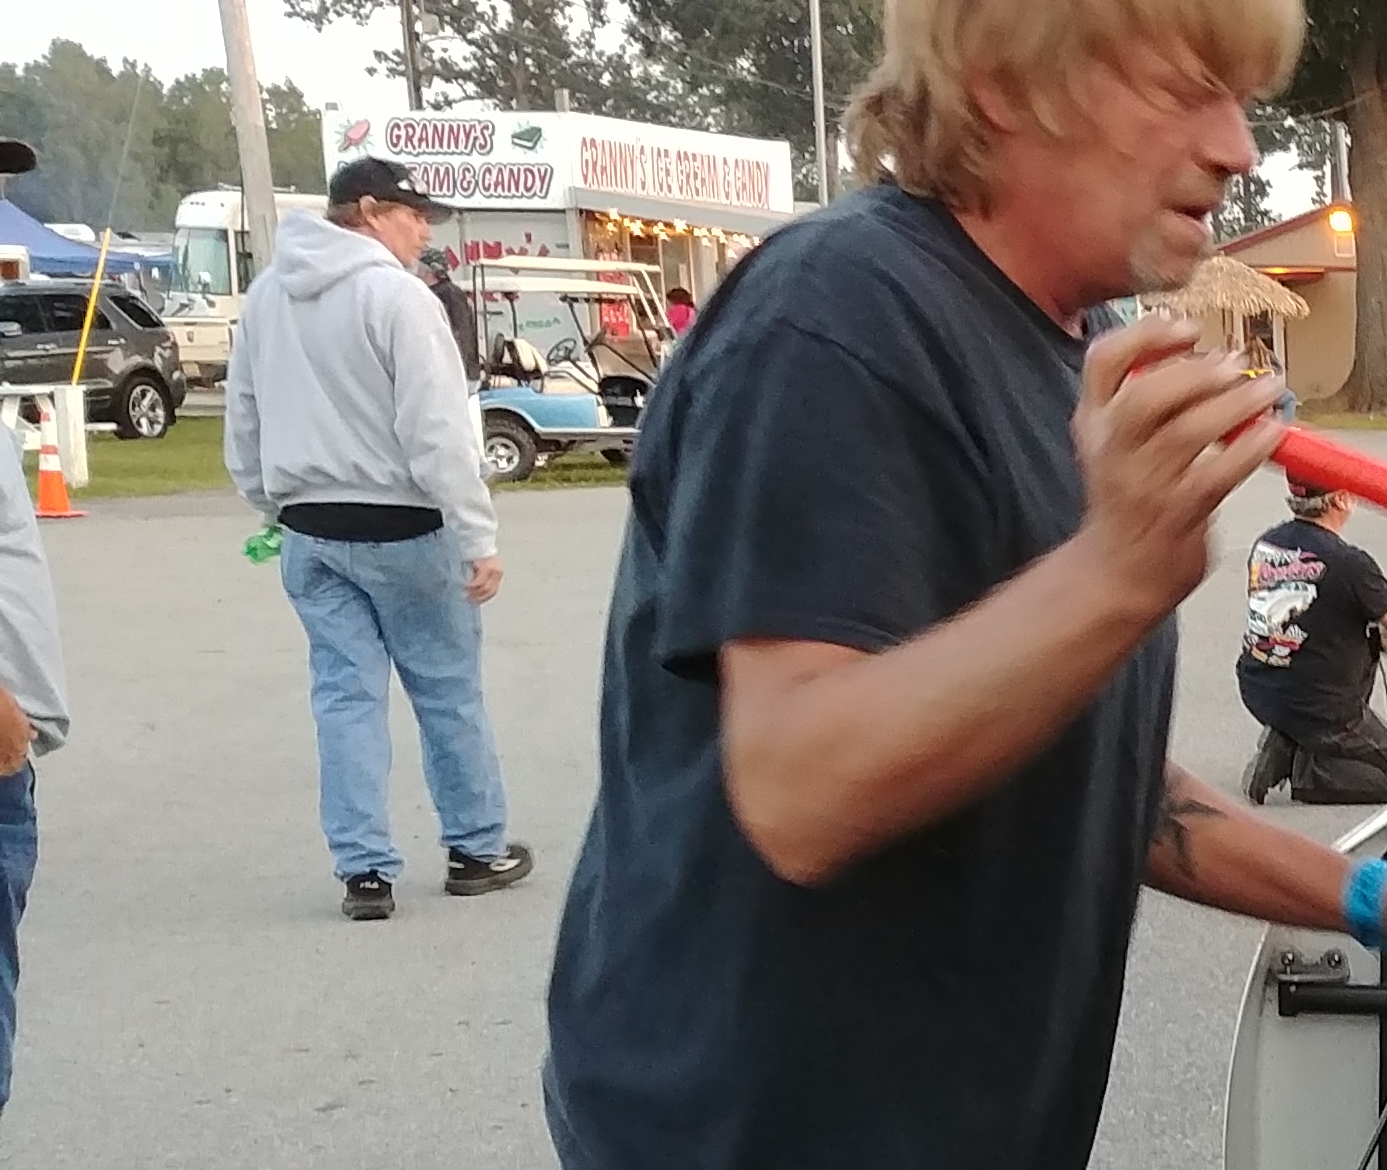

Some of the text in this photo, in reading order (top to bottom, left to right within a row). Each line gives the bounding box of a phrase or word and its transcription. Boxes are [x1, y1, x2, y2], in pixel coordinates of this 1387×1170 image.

[387, 118, 494, 154] GRANNY'S
[457, 162, 477, 198] &
[479, 163, 553, 198] CANDY
[581, 136, 648, 194] GRANNY'S
[650, 146, 674, 198] ICE
[676, 150, 720, 202] CREAM
[734, 157, 770, 209] CANDY
